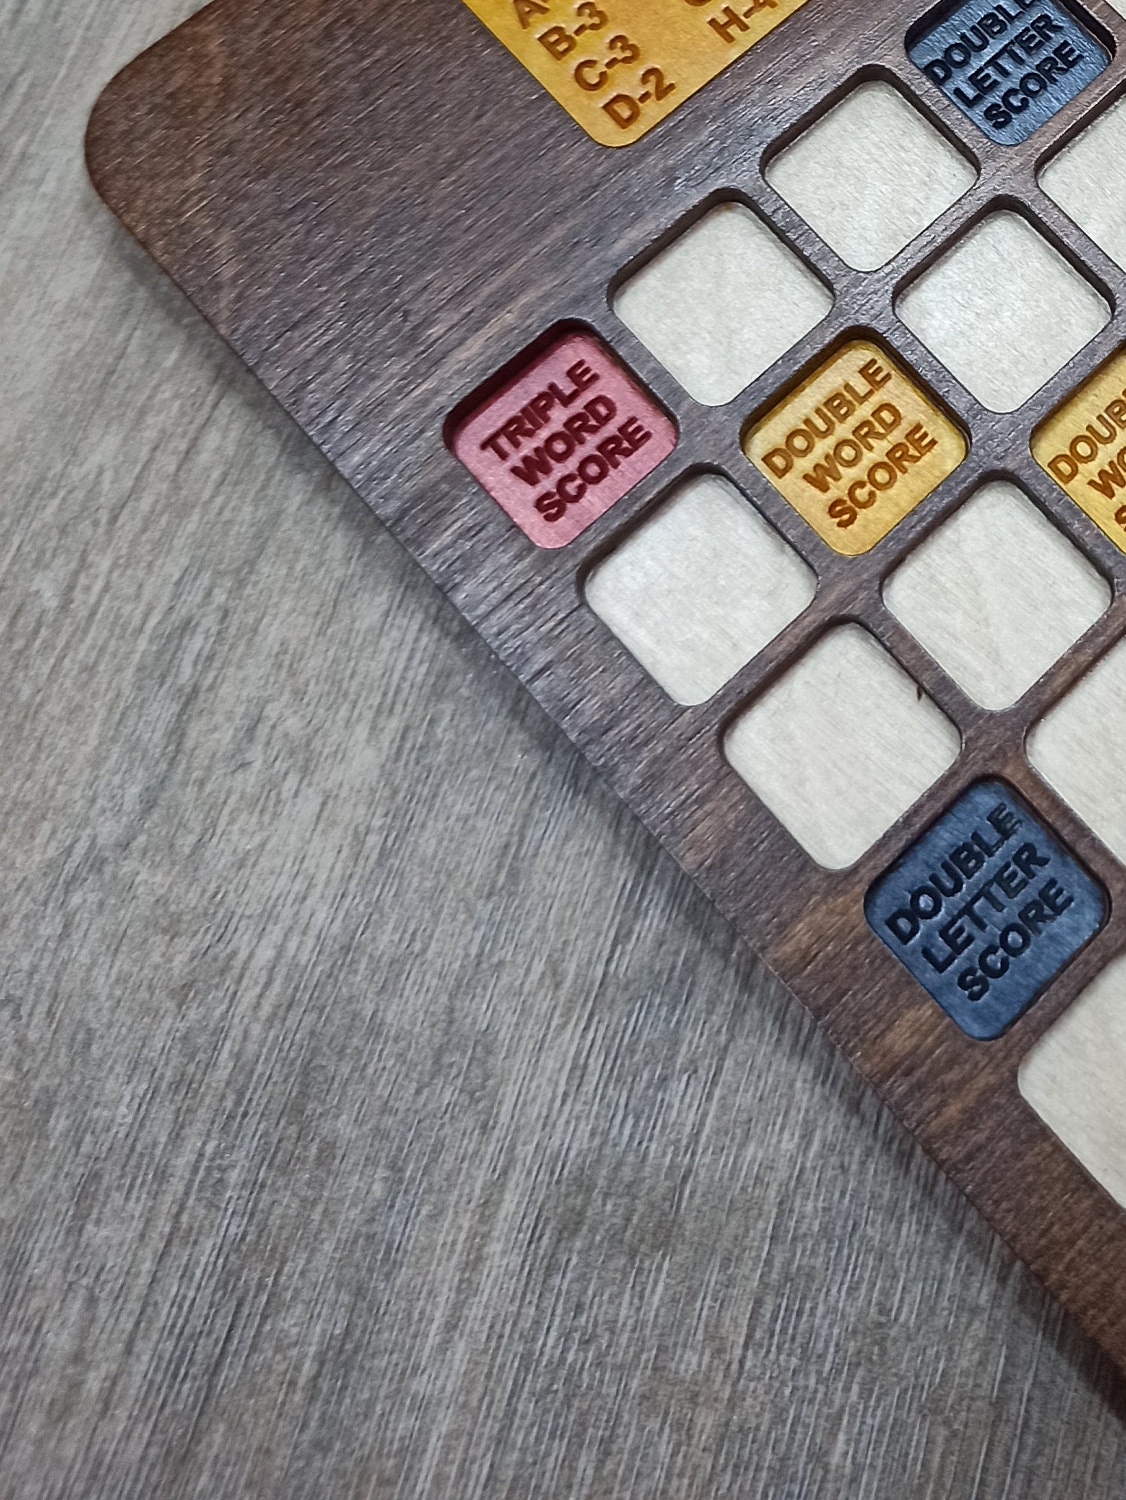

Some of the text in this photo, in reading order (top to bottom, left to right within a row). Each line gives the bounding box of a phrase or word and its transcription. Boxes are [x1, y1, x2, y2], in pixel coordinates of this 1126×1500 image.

[536, 1, 609, 61] B-3
[573, 34, 640, 91] C-3
[953, 13, 1064, 108] LETTER
[601, 67, 676, 129] D-2
[984, 40, 1084, 129] SCORE
[479, 358, 600, 462] TRIPLE
[509, 394, 617, 487] WORD
[761, 357, 892, 480] DOUBLE
[802, 402, 902, 494] WORD
[533, 416, 653, 522] SCORE
[827, 421, 938, 529] SCORE
[884, 802, 1024, 946] DOUBLE
[921, 841, 1051, 975] LETTER
[957, 877, 1075, 1002] SCORE
